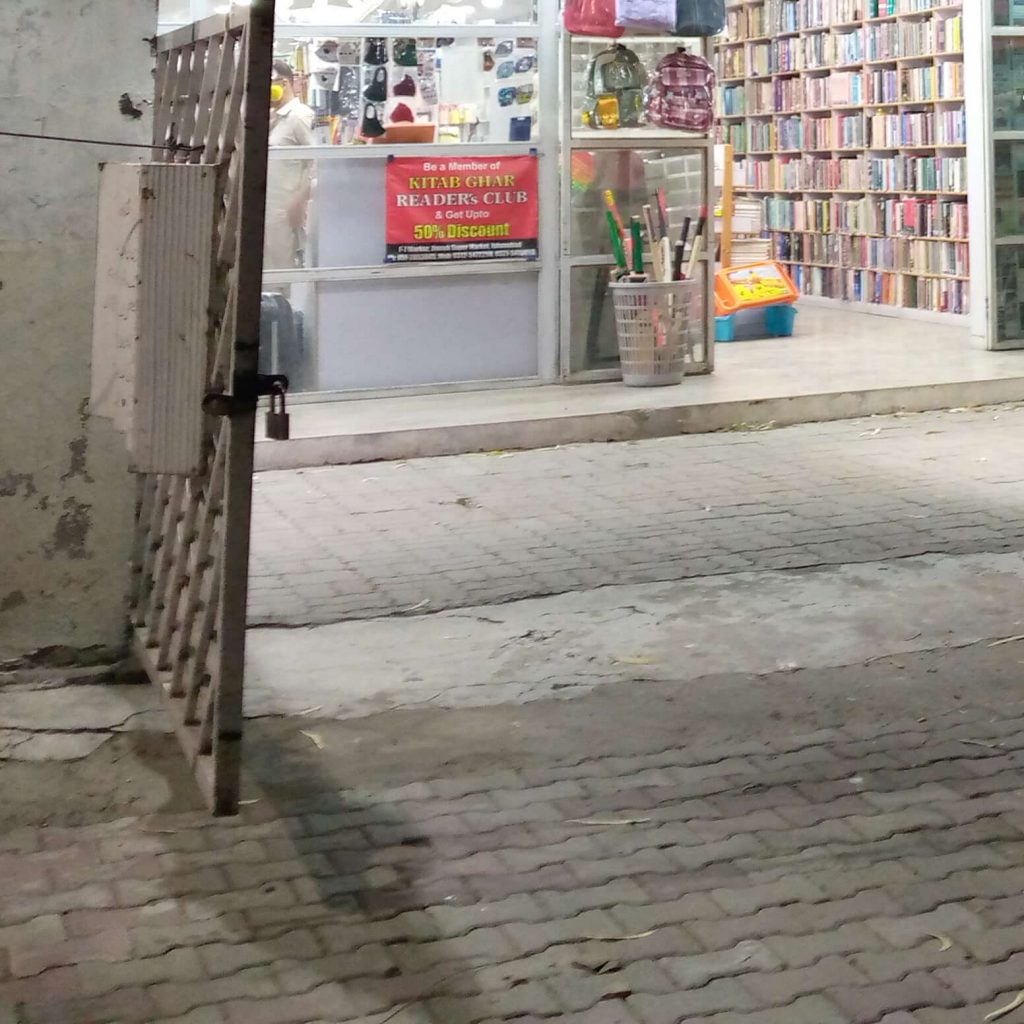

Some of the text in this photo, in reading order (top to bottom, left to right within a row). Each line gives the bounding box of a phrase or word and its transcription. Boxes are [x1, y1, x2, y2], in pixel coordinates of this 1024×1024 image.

[423, 162, 436, 171] Be
[448, 162, 488, 171] Member
[489, 161, 501, 170] of
[409, 175, 515, 189] KITAB GHAR
[483, 191, 528, 204] CLUB
[435, 210, 490, 220] & Get Upto
[414, 224, 510, 240] 50% Discount
